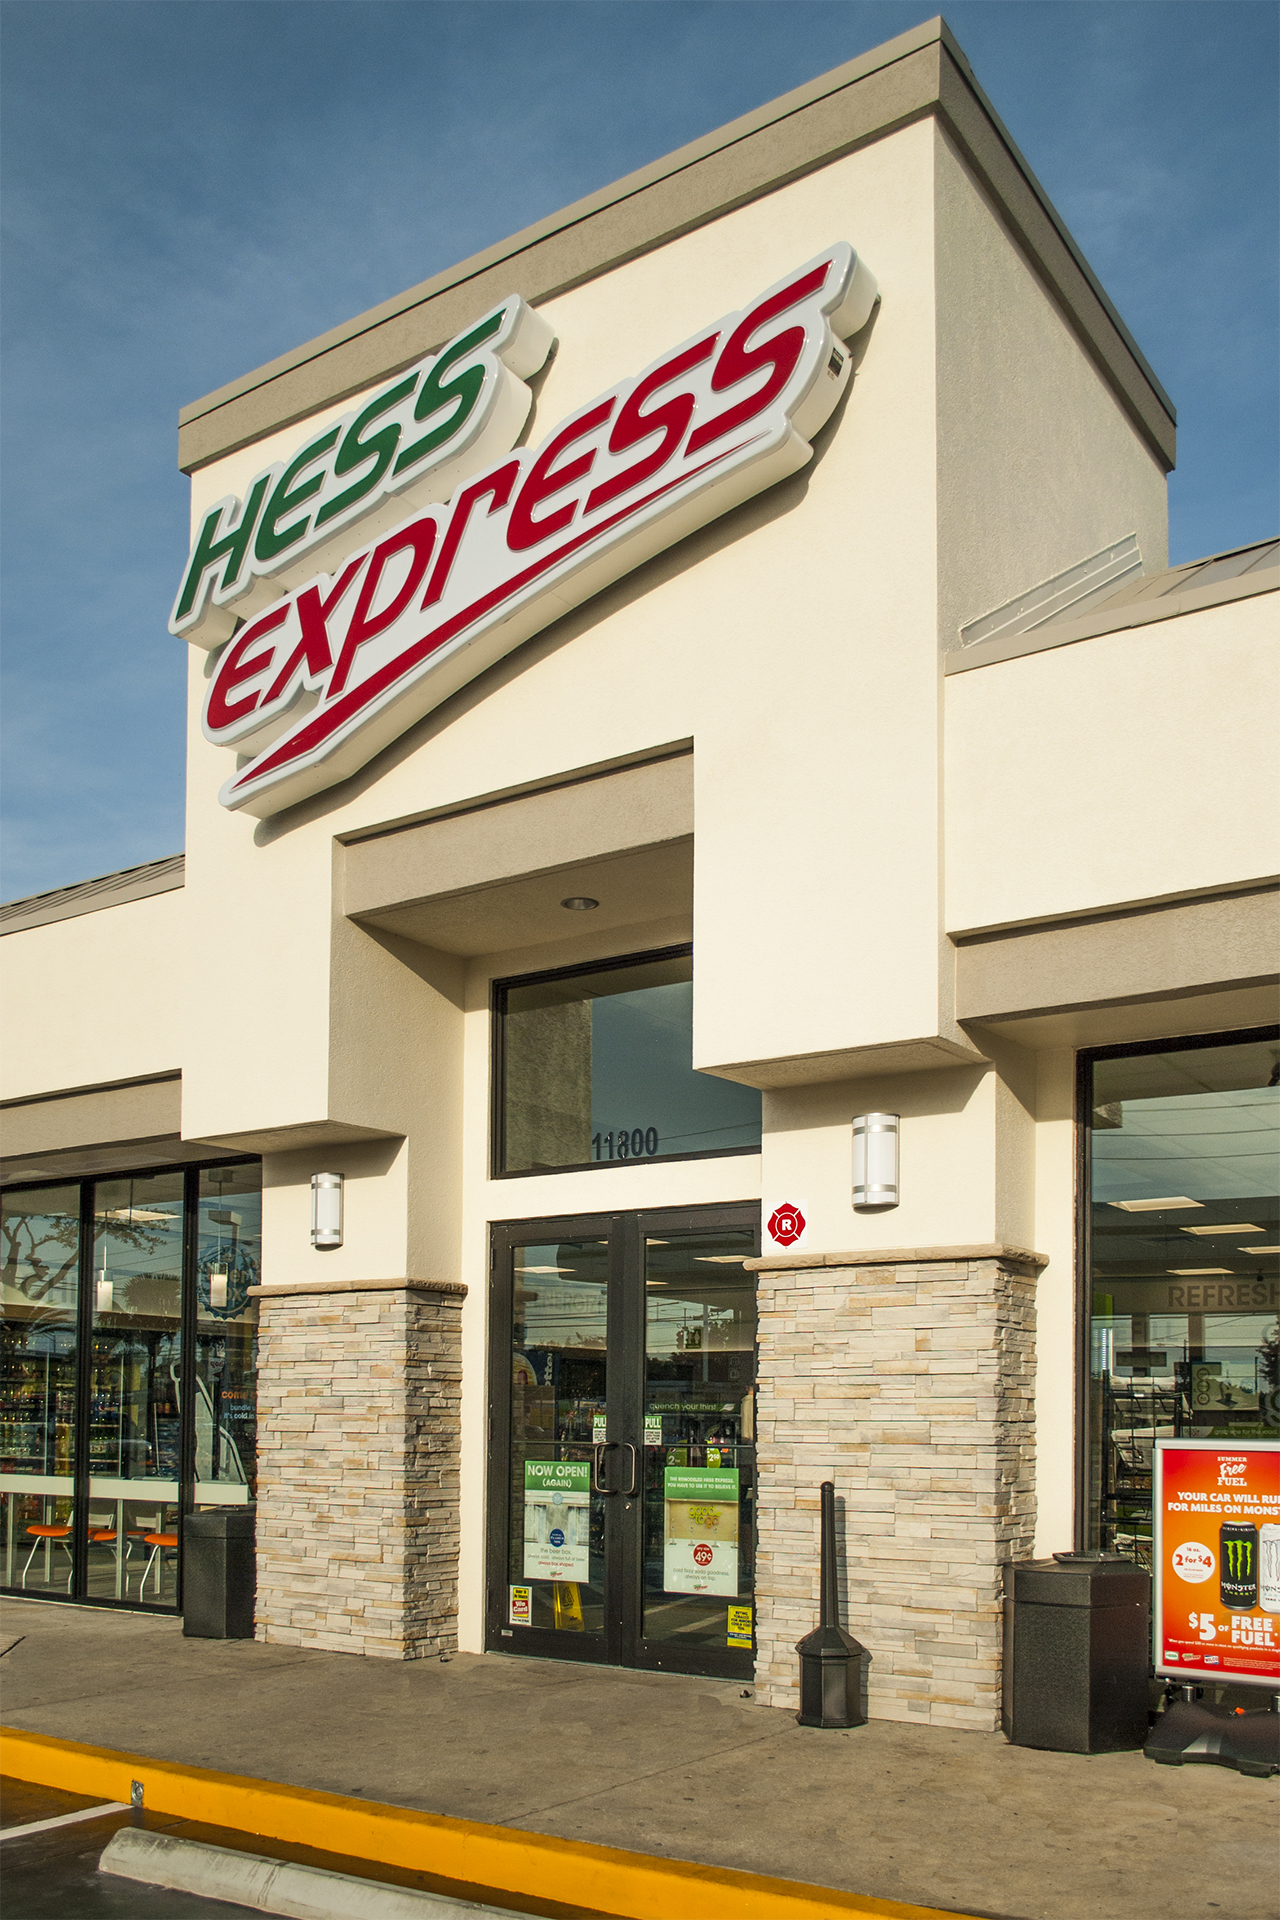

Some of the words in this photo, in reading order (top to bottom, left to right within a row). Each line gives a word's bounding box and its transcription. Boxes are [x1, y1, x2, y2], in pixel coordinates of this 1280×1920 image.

[175, 308, 506, 620] HESS
[592, 1127, 658, 1160] 11800
[781, 1219, 792, 1231] R
[650, 1403, 680, 1411] quench
[681, 1402, 698, 1411] your
[646, 1417, 661, 1428] PULL
[527, 1465, 553, 1476] NOW
[556, 1466, 588, 1477] OPEN!
[1220, 1463, 1246, 1480] Free
[542, 1478, 572, 1488] (AGAIN)
[1217, 1477, 1247, 1486] FUEL
[1177, 1491, 1208, 1502] YOUR
[1209, 1493, 1232, 1503] CAR
[1232, 1494, 1260, 1504] WILL
[688, 1505, 715, 1519] good
[1167, 1502, 1189, 1512] FOR
[1190, 1503, 1222, 1513] MILES
[1223, 1505, 1241, 1514] ON
[1243, 1506, 1280, 1516] MONS
[695, 1513, 705, 1524] to
[705, 1515, 719, 1528] go
[695, 1551, 712, 1562] 49¢
[1175, 1553, 1184, 1566] 2
[1185, 1555, 1197, 1563] for
[1188, 1611, 1217, 1641] $5
[1218, 1624, 1229, 1632] OF
[1231, 1615, 1273, 1632] FREE
